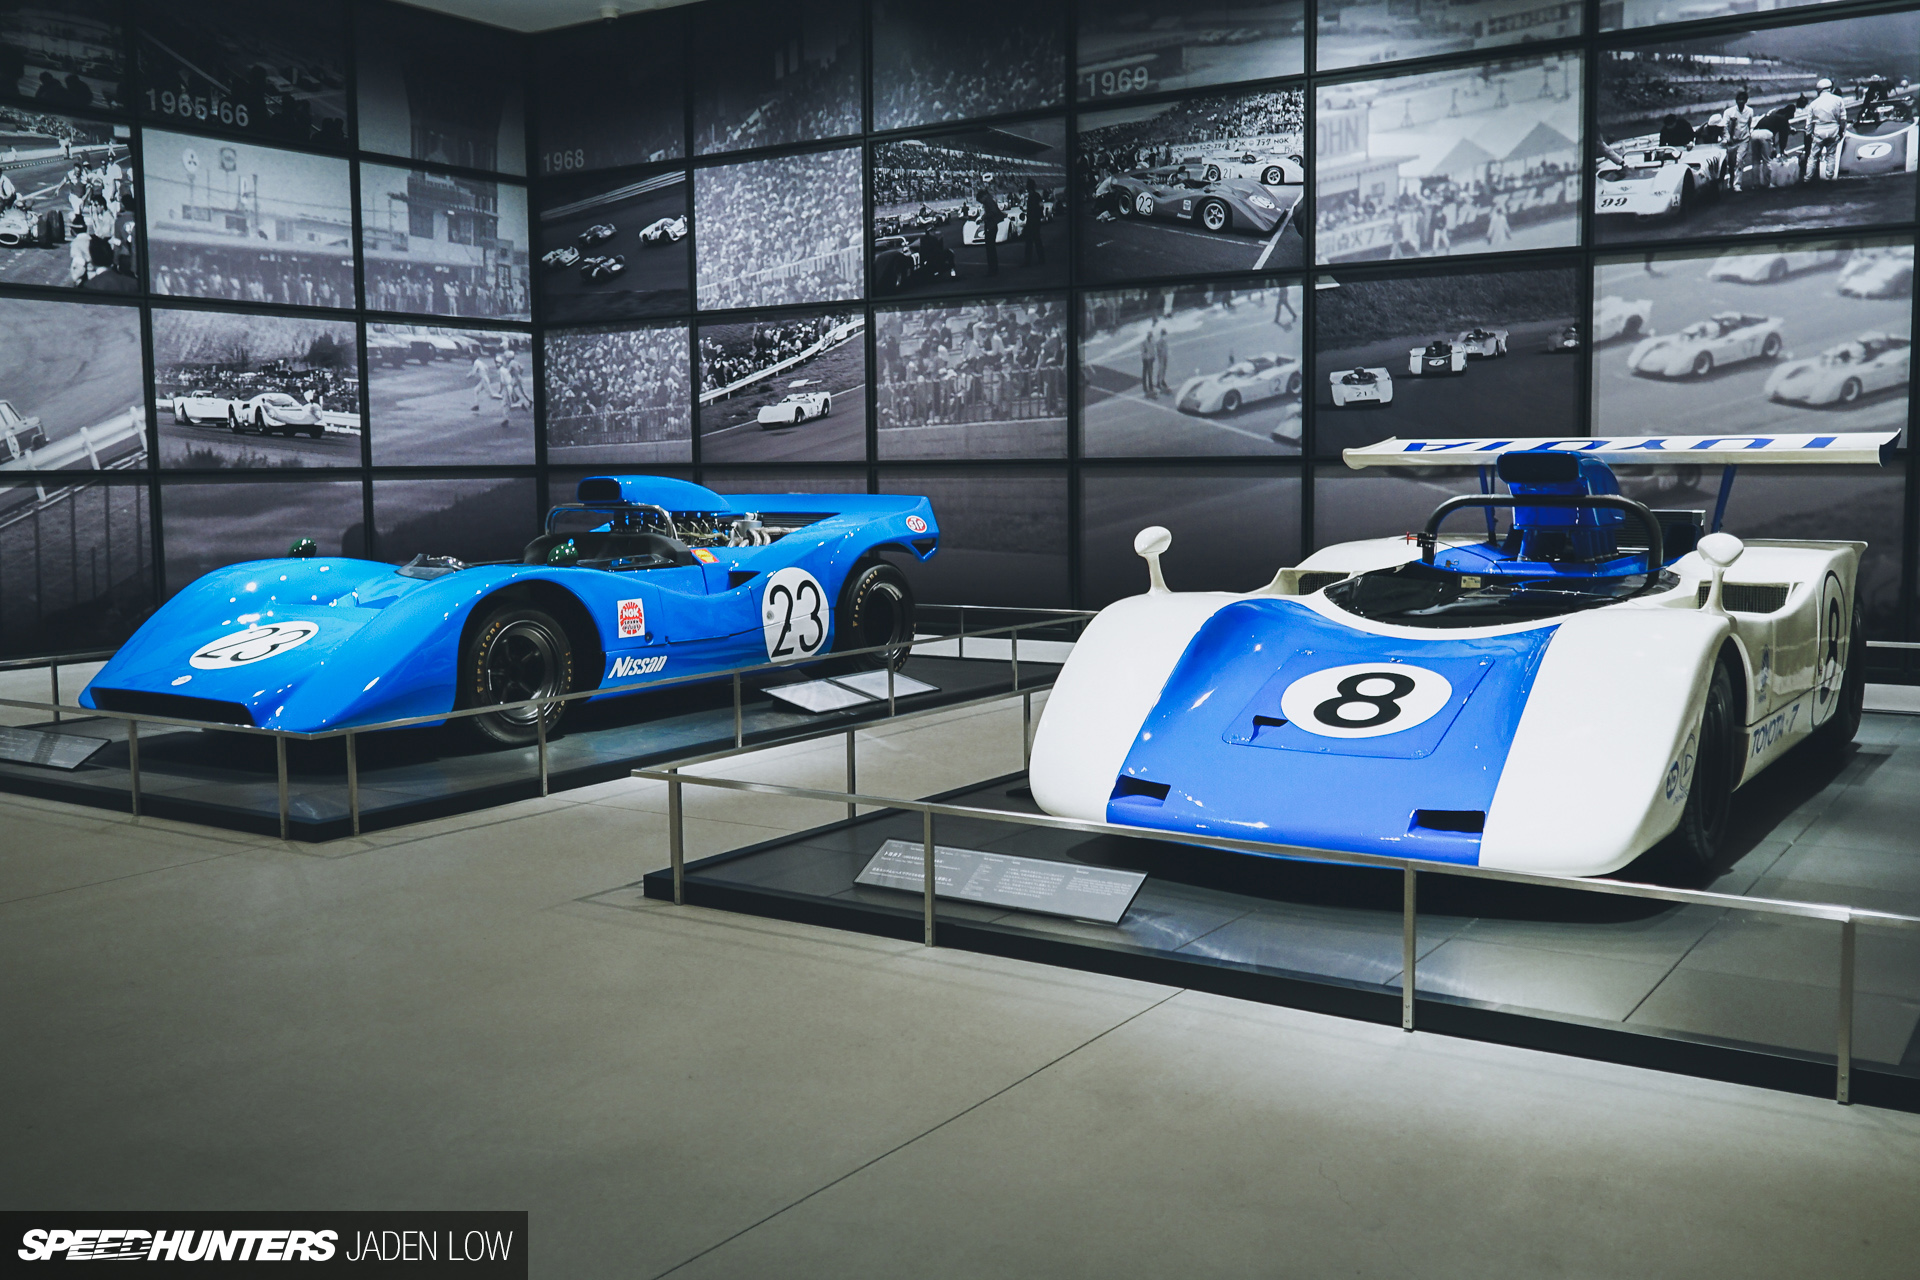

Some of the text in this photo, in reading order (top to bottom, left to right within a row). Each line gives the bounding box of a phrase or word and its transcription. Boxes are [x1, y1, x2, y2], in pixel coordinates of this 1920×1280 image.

[1085, 67, 1149, 97] 1969
[543, 148, 585, 172] 1968
[1868, 144, 1883, 155] 7
[1223, 168, 1232, 179] 21
[1138, 195, 1152, 215] 23
[908, 517, 925, 530] STP
[622, 608, 639, 618] NGK
[769, 579, 824, 659] 23
[194, 627, 312, 662] 23
[607, 655, 668, 679] Nissan
[1313, 671, 1416, 729] 8
